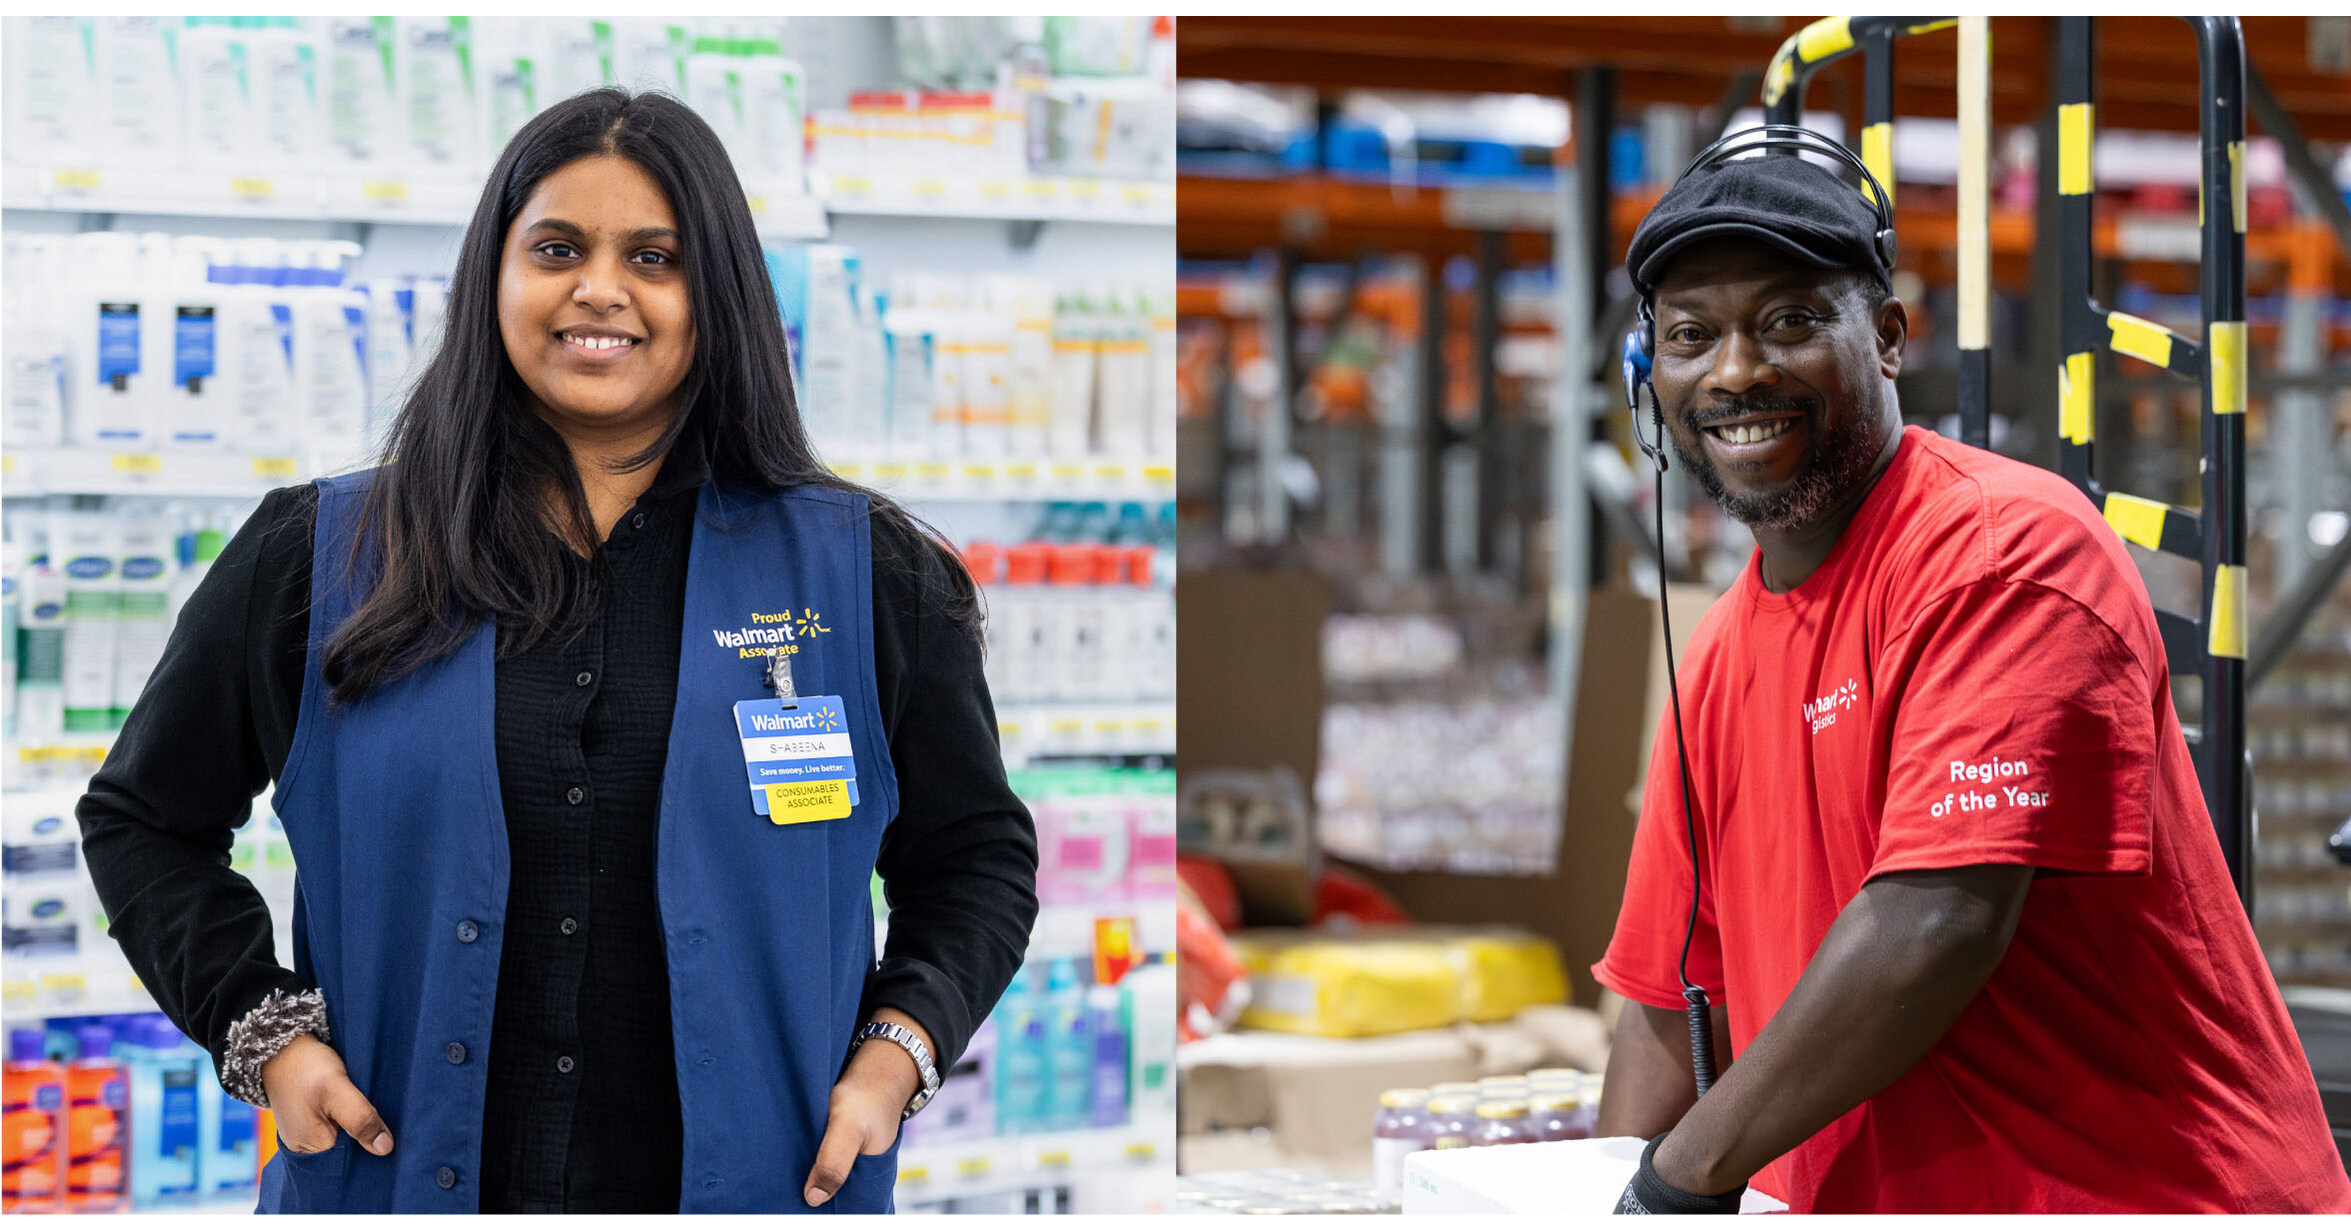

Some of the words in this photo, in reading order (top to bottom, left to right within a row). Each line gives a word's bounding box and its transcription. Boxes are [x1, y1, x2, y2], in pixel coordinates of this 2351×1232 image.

[751, 609, 791, 624] Proud
[713, 623, 795, 648] Walmart
[739, 644, 799, 659] Assoate
[751, 712, 816, 732] Walmart
[1812, 712, 1836, 735] gistics
[760, 768, 778, 776] Save
[778, 767, 804, 776] money.
[805, 765, 820, 773] Live
[821, 764, 845, 773] better.
[1950, 756, 2028, 784] Region
[776, 783, 839, 798] CONSUMABLES
[787, 795, 834, 808] ASSOCIATE
[1931, 793, 1954, 817] of
[1959, 790, 1997, 812] the
[2002, 786, 2049, 807] Year
